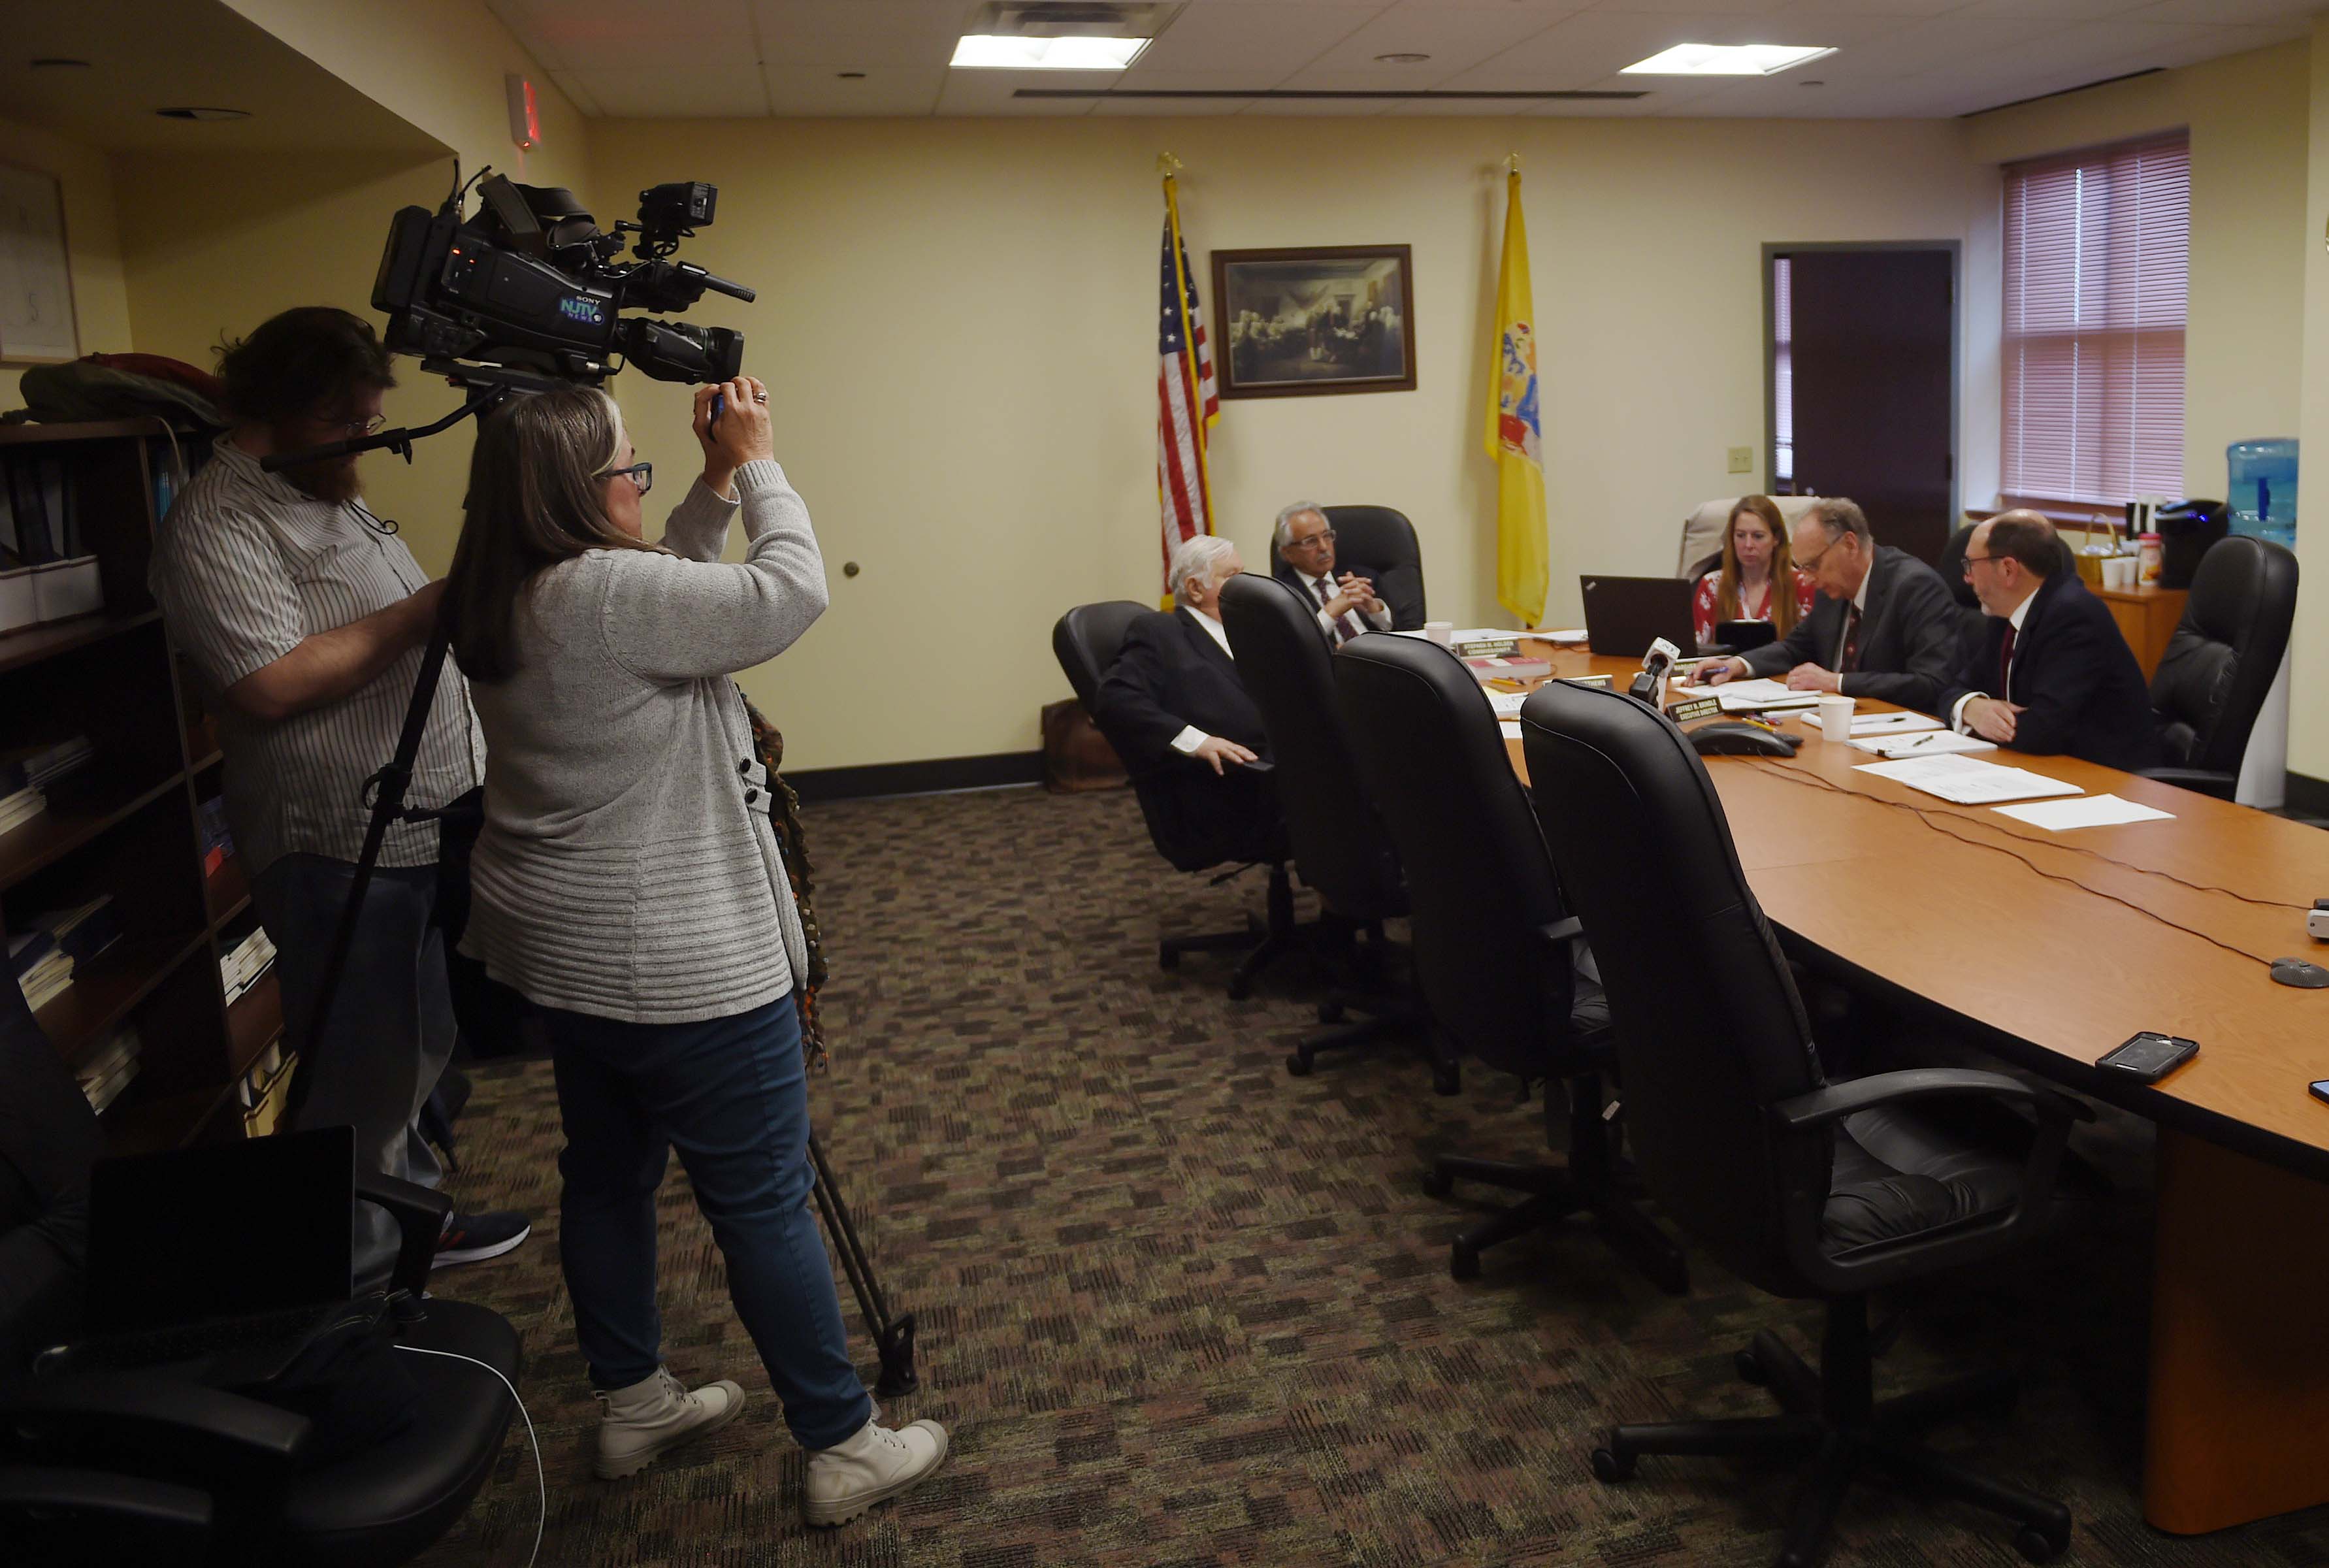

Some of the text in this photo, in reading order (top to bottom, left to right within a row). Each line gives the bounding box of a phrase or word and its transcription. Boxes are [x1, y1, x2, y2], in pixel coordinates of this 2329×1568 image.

[576, 295, 600, 305] SONY
[561, 299, 597, 317] NJTV
[1676, 704, 1693, 714] JEFFREY
